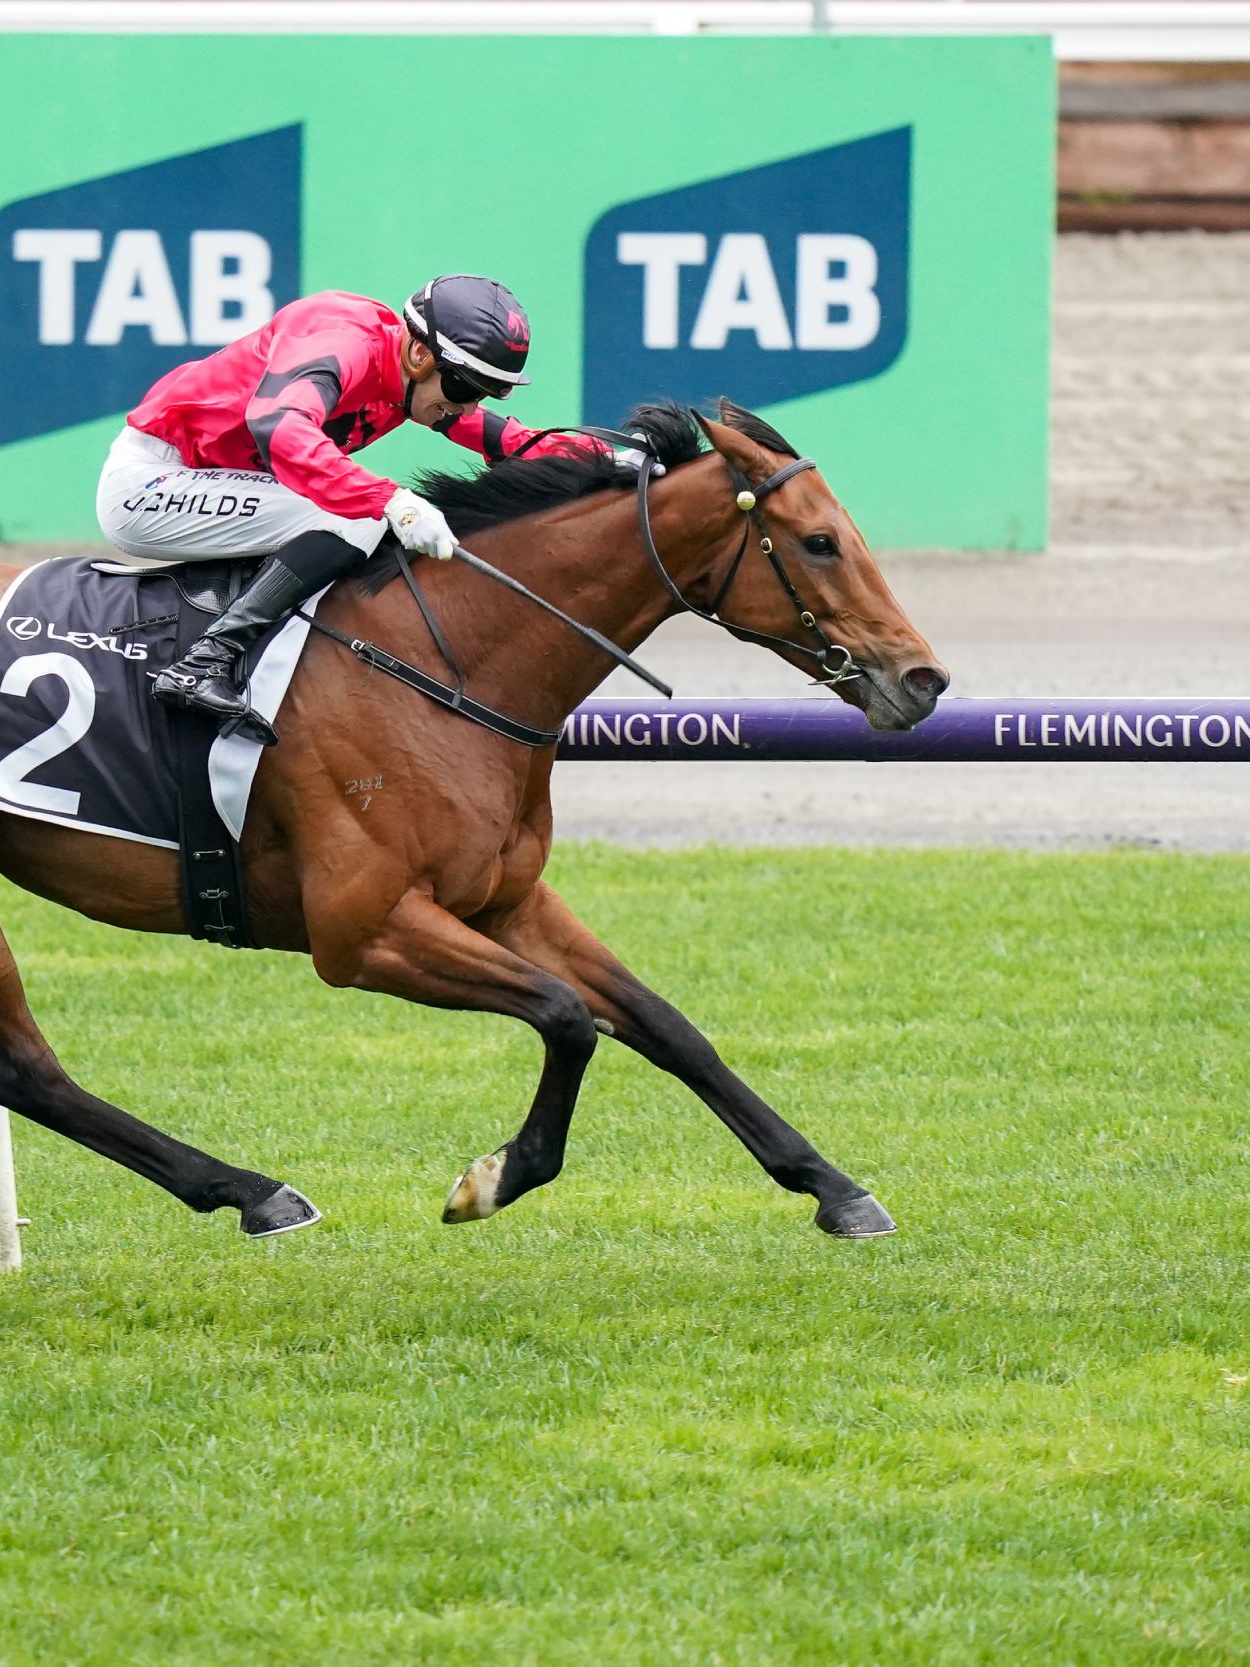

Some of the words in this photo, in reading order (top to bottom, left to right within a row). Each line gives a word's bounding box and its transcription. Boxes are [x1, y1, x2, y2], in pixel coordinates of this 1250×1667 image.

[12, 229, 274, 347] TAB
[617, 232, 881, 351] TAB
[47, 622, 148, 660] LEXUS
